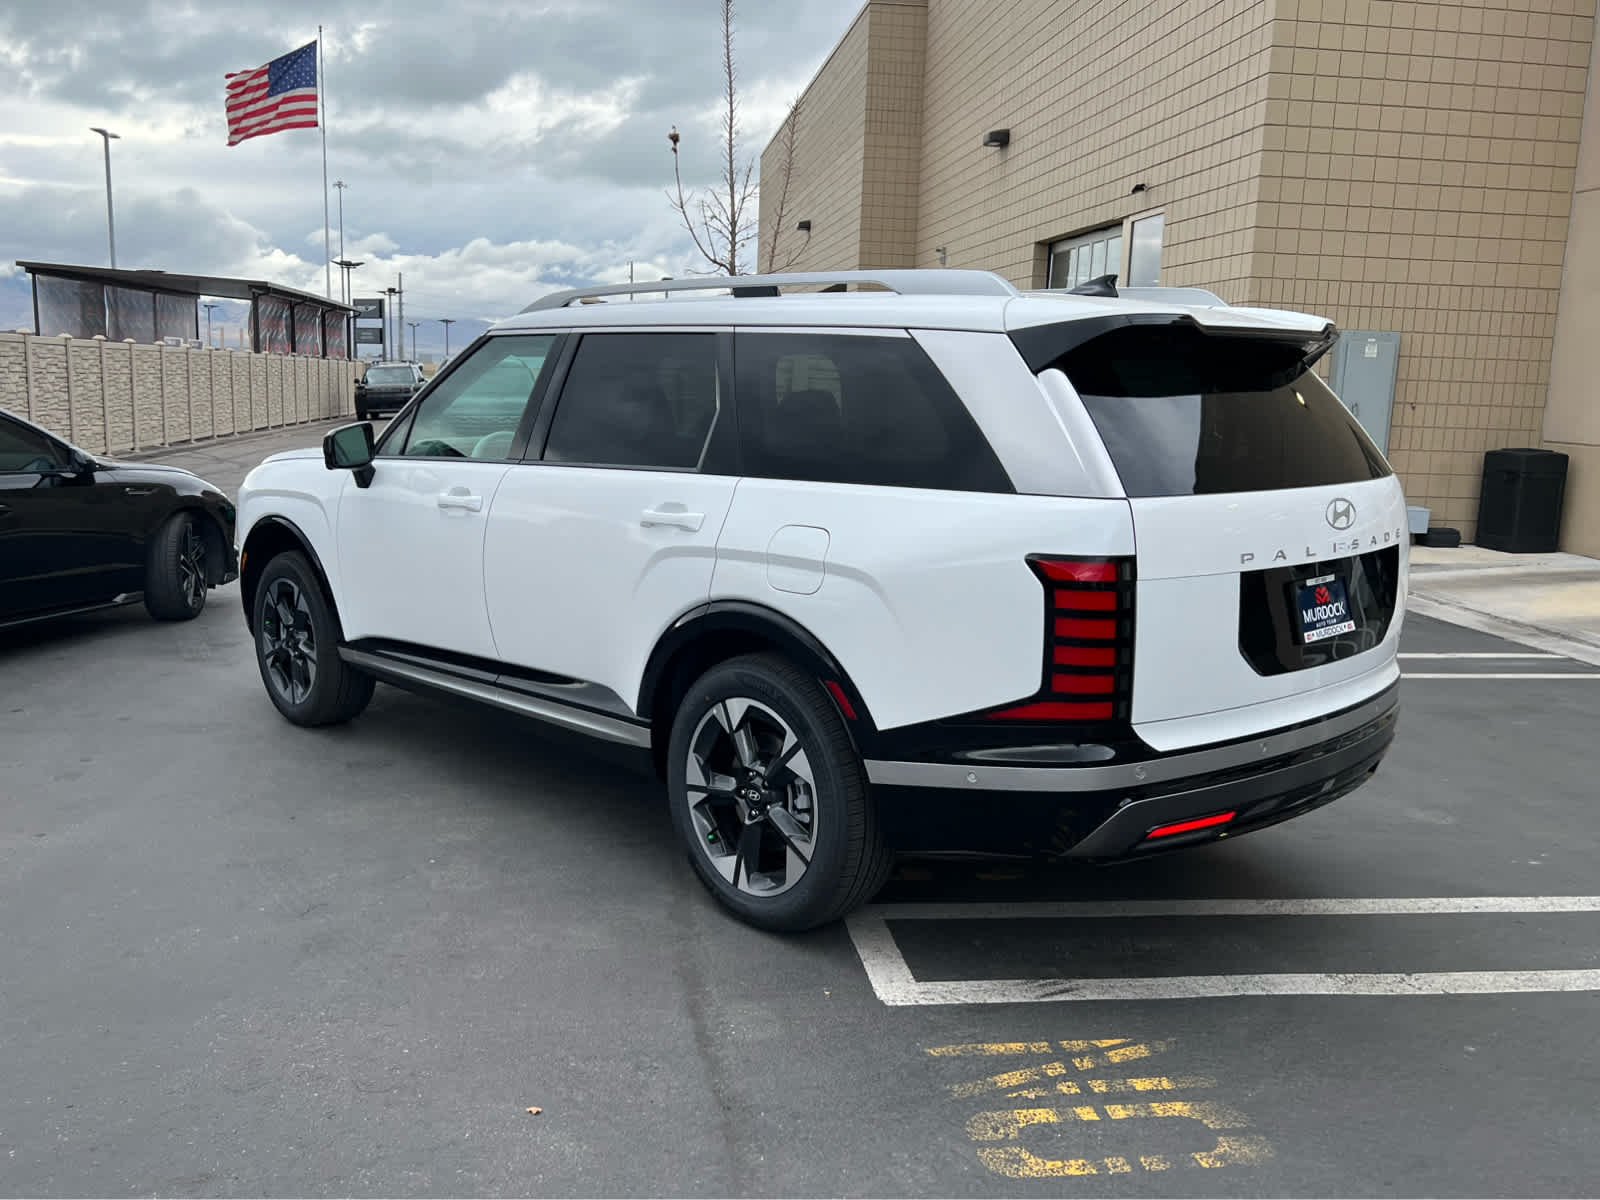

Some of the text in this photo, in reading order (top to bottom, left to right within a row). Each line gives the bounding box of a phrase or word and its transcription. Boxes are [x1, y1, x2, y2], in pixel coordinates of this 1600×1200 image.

[1240, 528, 1400, 564] PALISADE
[1302, 601, 1346, 624] MURDOCK
[1315, 625, 1344, 638] MURDOCK
